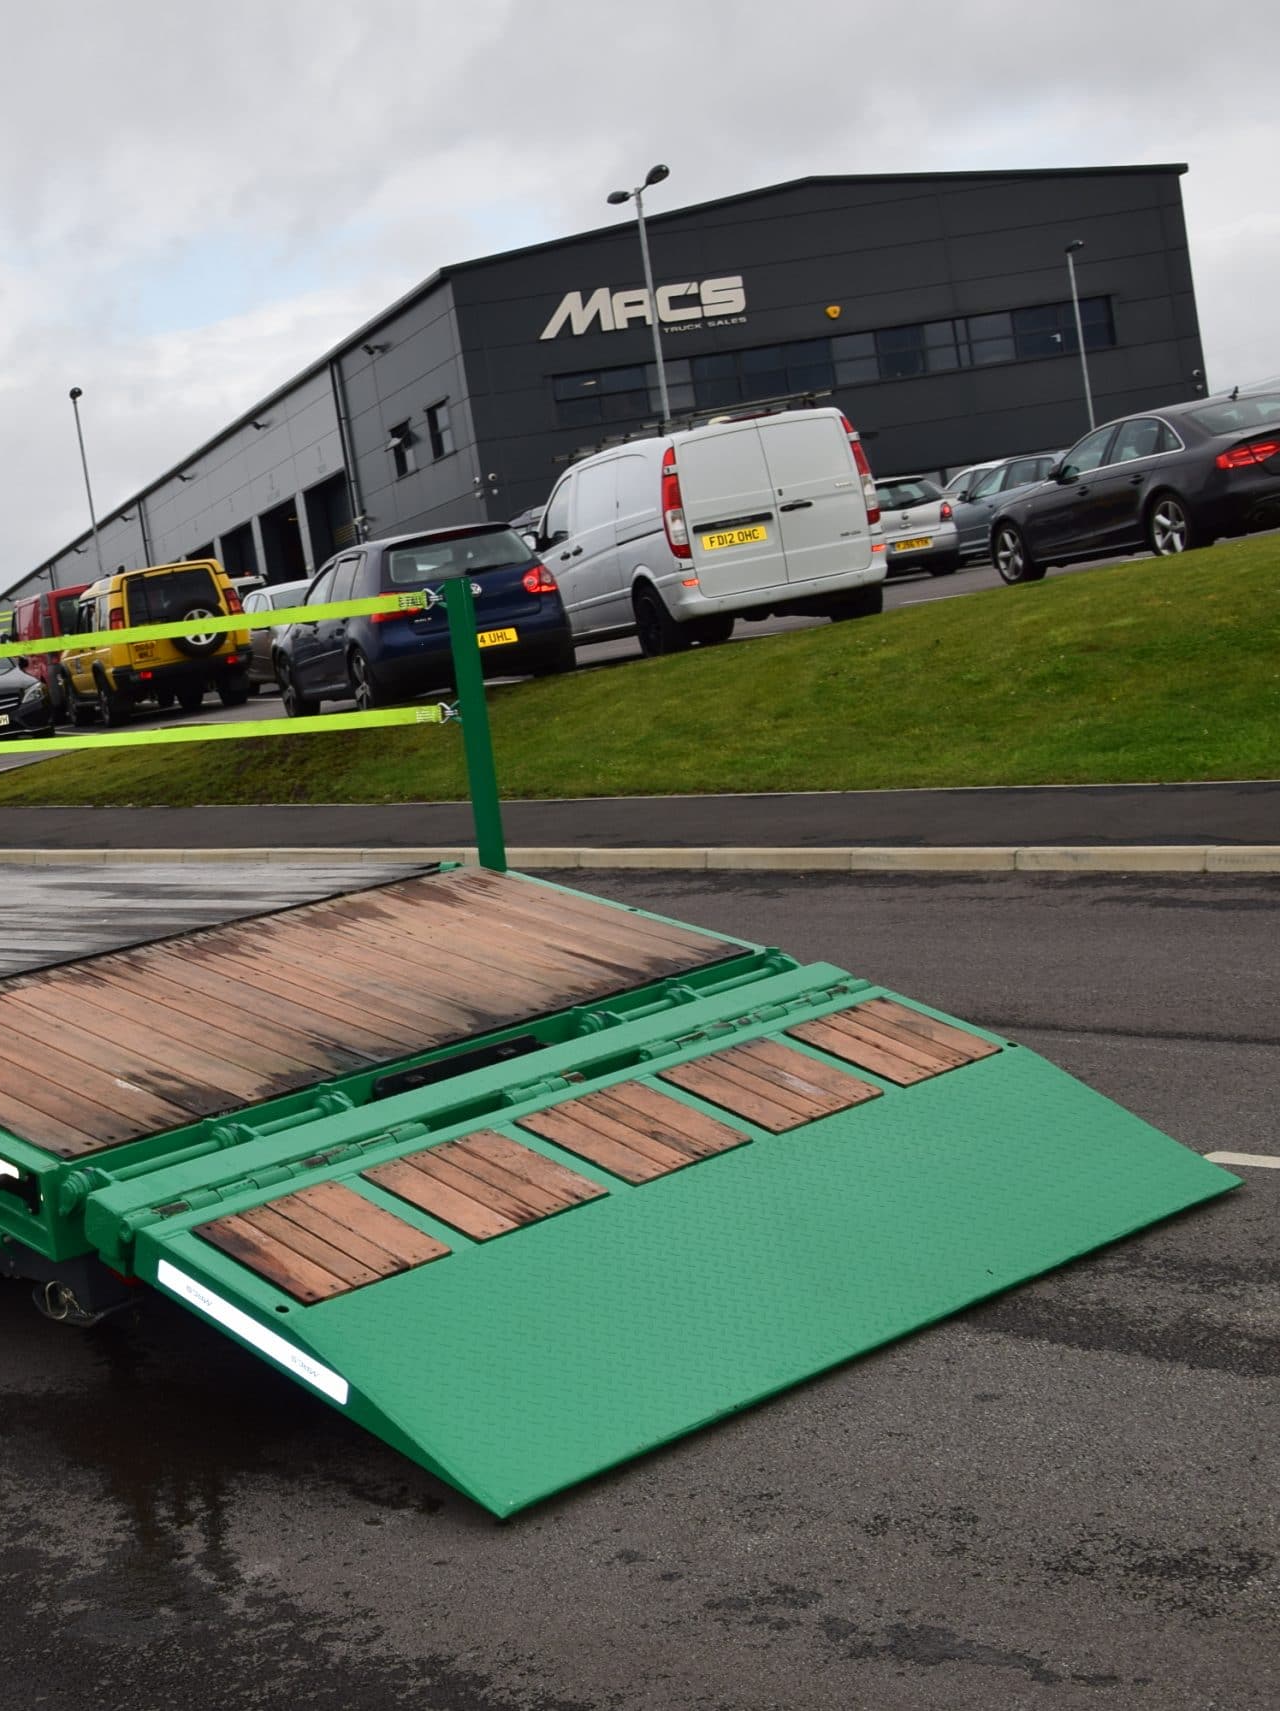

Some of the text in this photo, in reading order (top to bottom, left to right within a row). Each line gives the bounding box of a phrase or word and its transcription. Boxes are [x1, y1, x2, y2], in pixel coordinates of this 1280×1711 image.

[663, 316, 747, 334] TRUCK SALES
[709, 528, 759, 548] FD12 OHC
[488, 631, 512, 643] UHL
